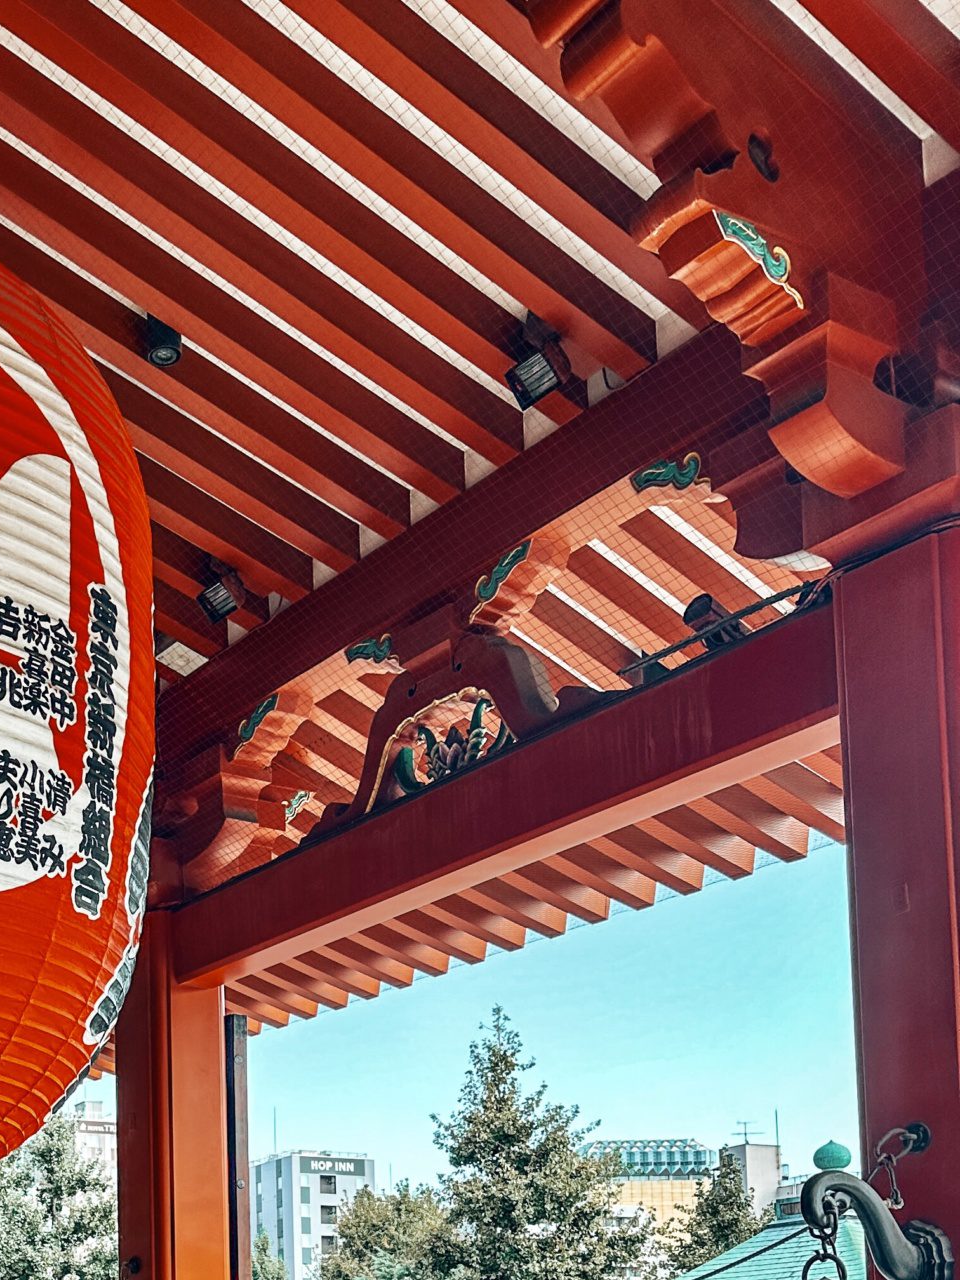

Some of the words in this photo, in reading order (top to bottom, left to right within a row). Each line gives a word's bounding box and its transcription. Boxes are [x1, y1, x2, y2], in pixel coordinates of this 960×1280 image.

[22, 604, 51, 720] 新喜楽
[50, 618, 76, 728] 金田中
[73, 586, 119, 916] 東京新橋組合
[15, 760, 45, 871] 小喜美
[40, 768, 74, 874] 清み
[311, 1161, 333, 1171] HOP
[335, 1162, 355, 1172] INN
